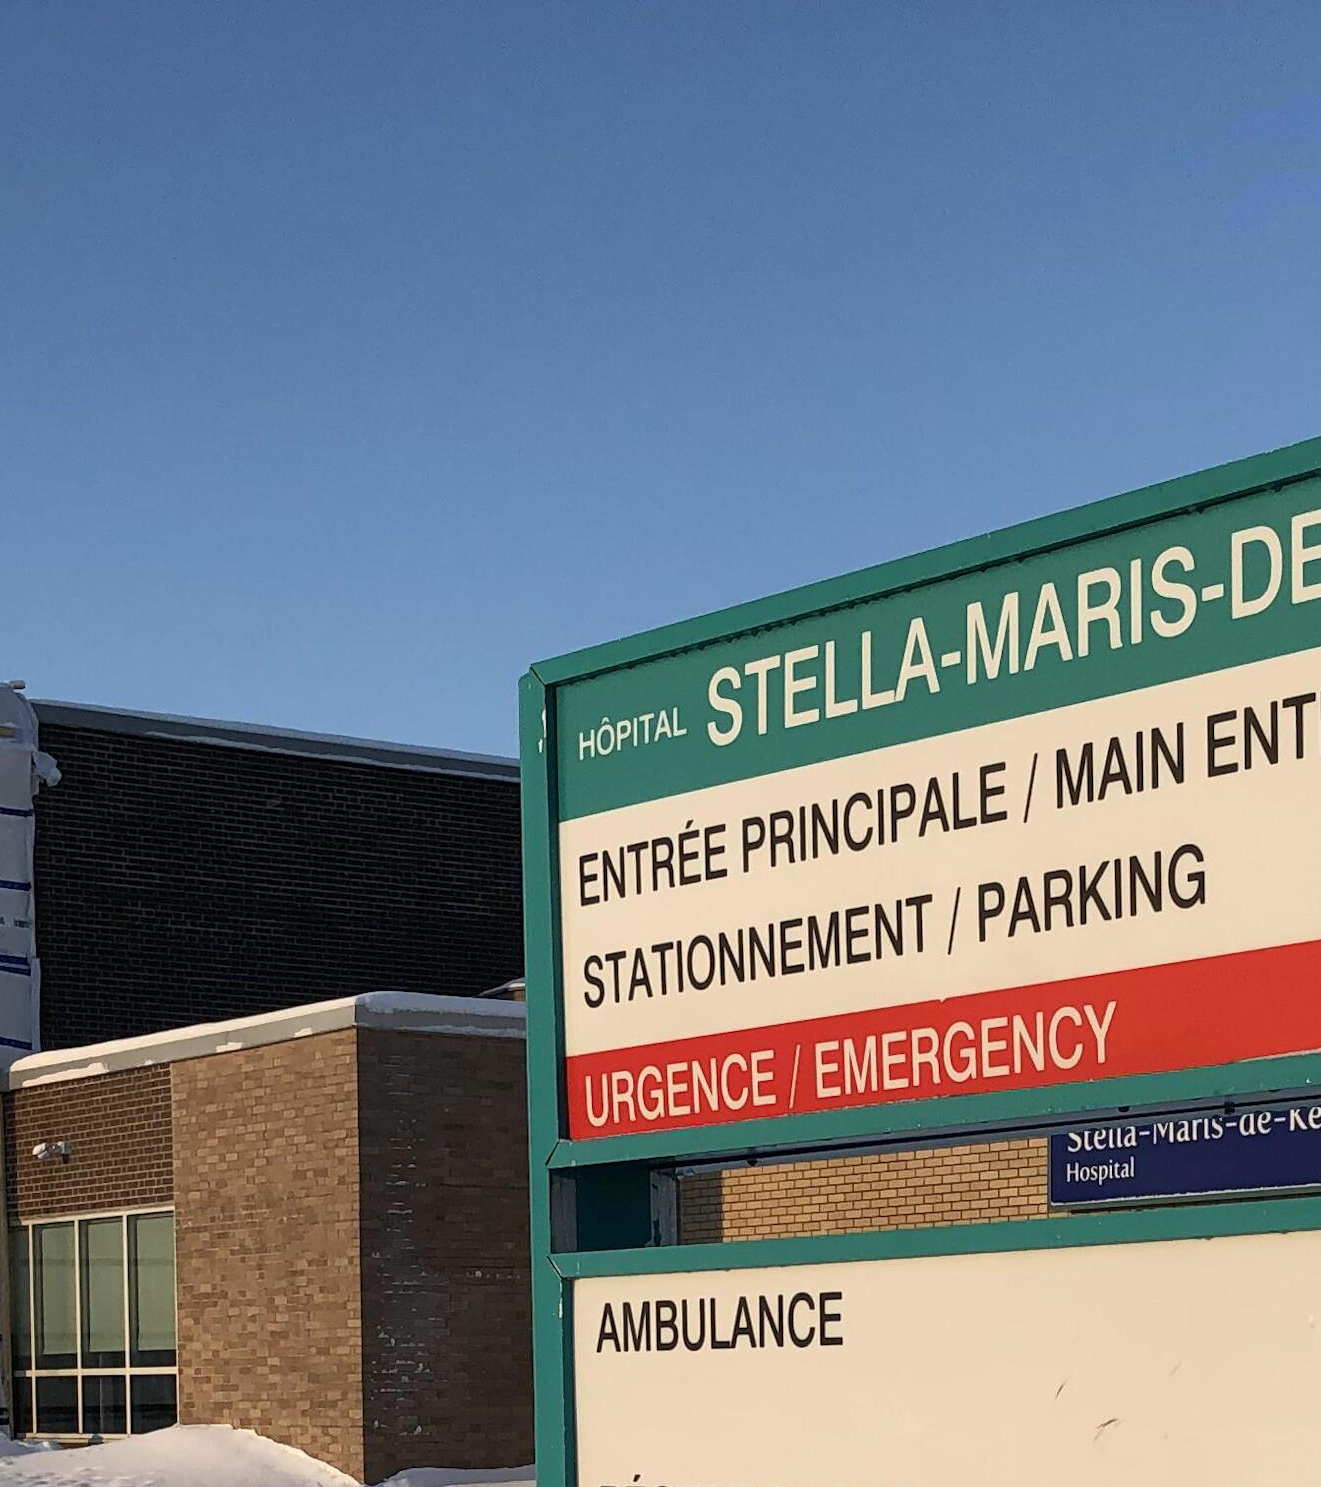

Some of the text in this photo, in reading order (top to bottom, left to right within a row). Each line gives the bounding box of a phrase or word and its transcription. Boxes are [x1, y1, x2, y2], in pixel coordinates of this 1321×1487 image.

[579, 707, 687, 760] HÔPITAL
[579, 819, 728, 907] ENTRÉE
[741, 761, 1009, 873] PRINCIPALE
[1023, 752, 1039, 824] /
[1055, 721, 1185, 809] MAIN
[583, 843, 1207, 1009] STATIONNEMENT / PARKING
[585, 1000, 1118, 1128] URGENCE / EMERGENCY
[1066, 1156, 1135, 1186] Hospital
[596, 1291, 844, 1354] AMBULANCE
